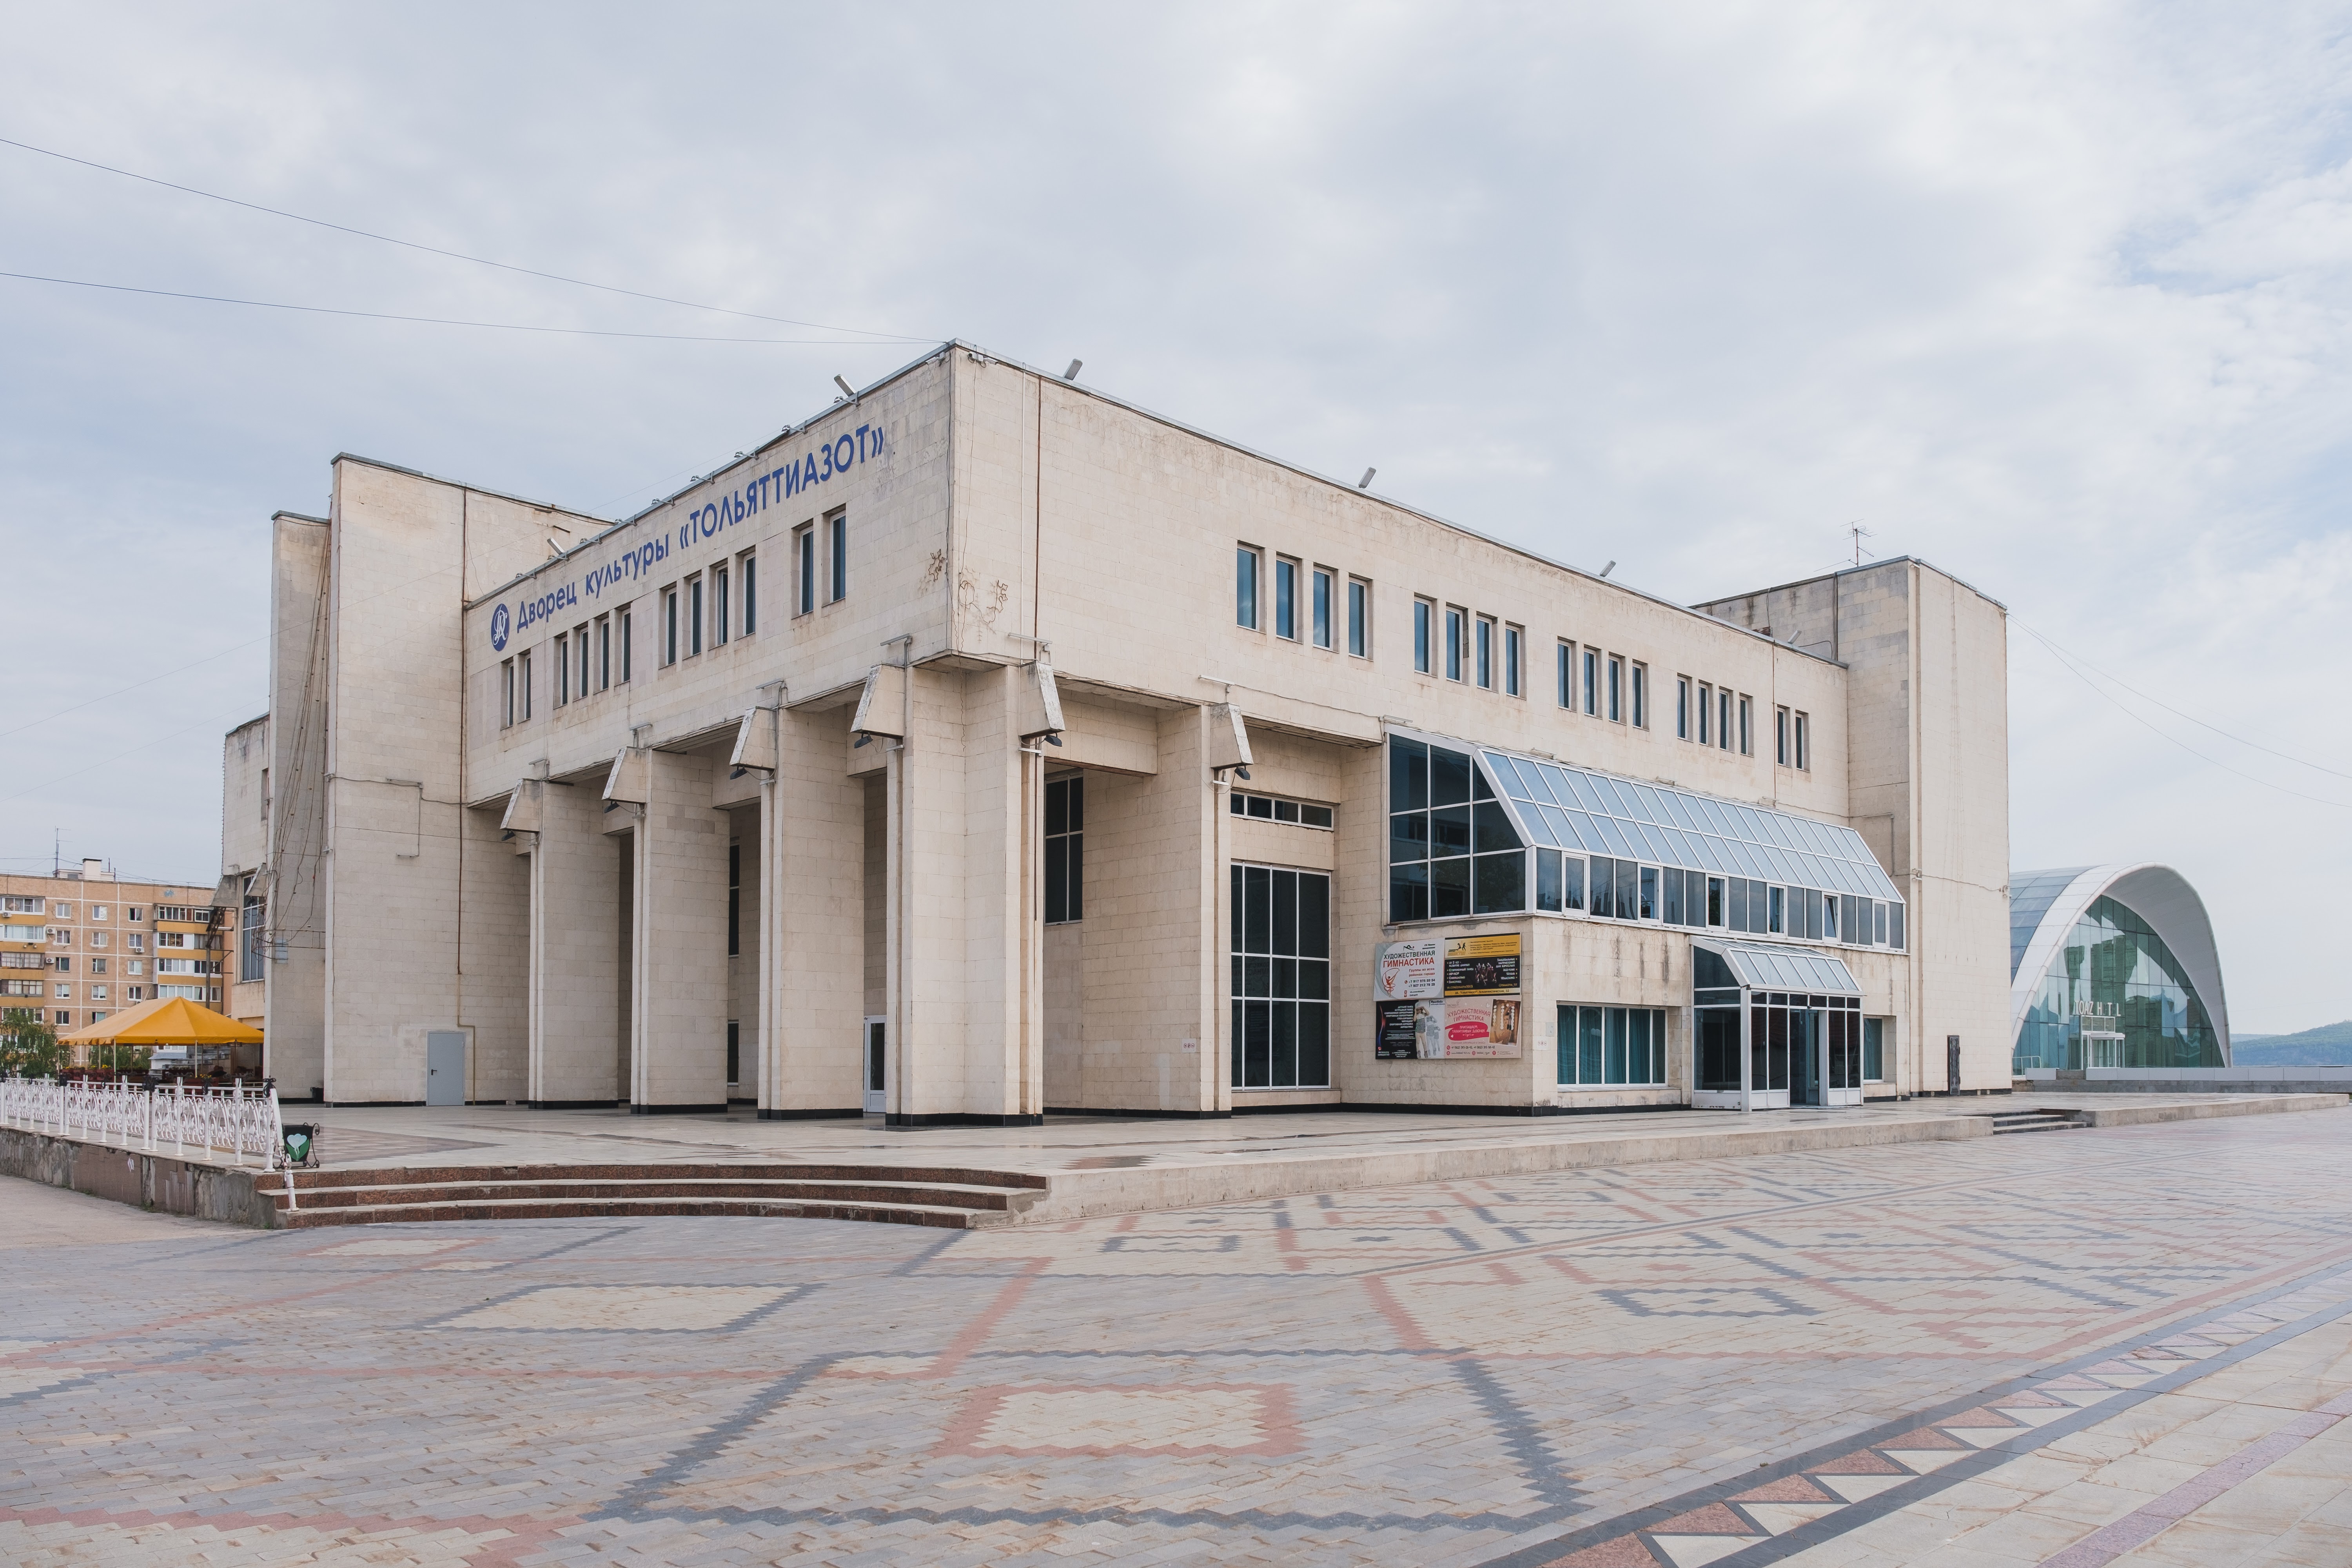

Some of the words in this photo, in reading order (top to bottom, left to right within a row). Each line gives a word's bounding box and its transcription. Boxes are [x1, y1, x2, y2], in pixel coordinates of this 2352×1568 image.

[517, 581, 577, 633] Дворец
[585, 533, 670, 601] культуры
[679, 424, 884, 550] «ТОЛЬЯТТИАЗОТ»
[1384, 950, 1435, 960] ХУДОЖЕСТВЕННАЯ
[1383, 957, 1434, 968] ГИМНАСТИКА
[1447, 1008, 1491, 1018] ХУДОЖЕСТВЕННАЯ
[2074, 1000, 2094, 1015] TOAZ
